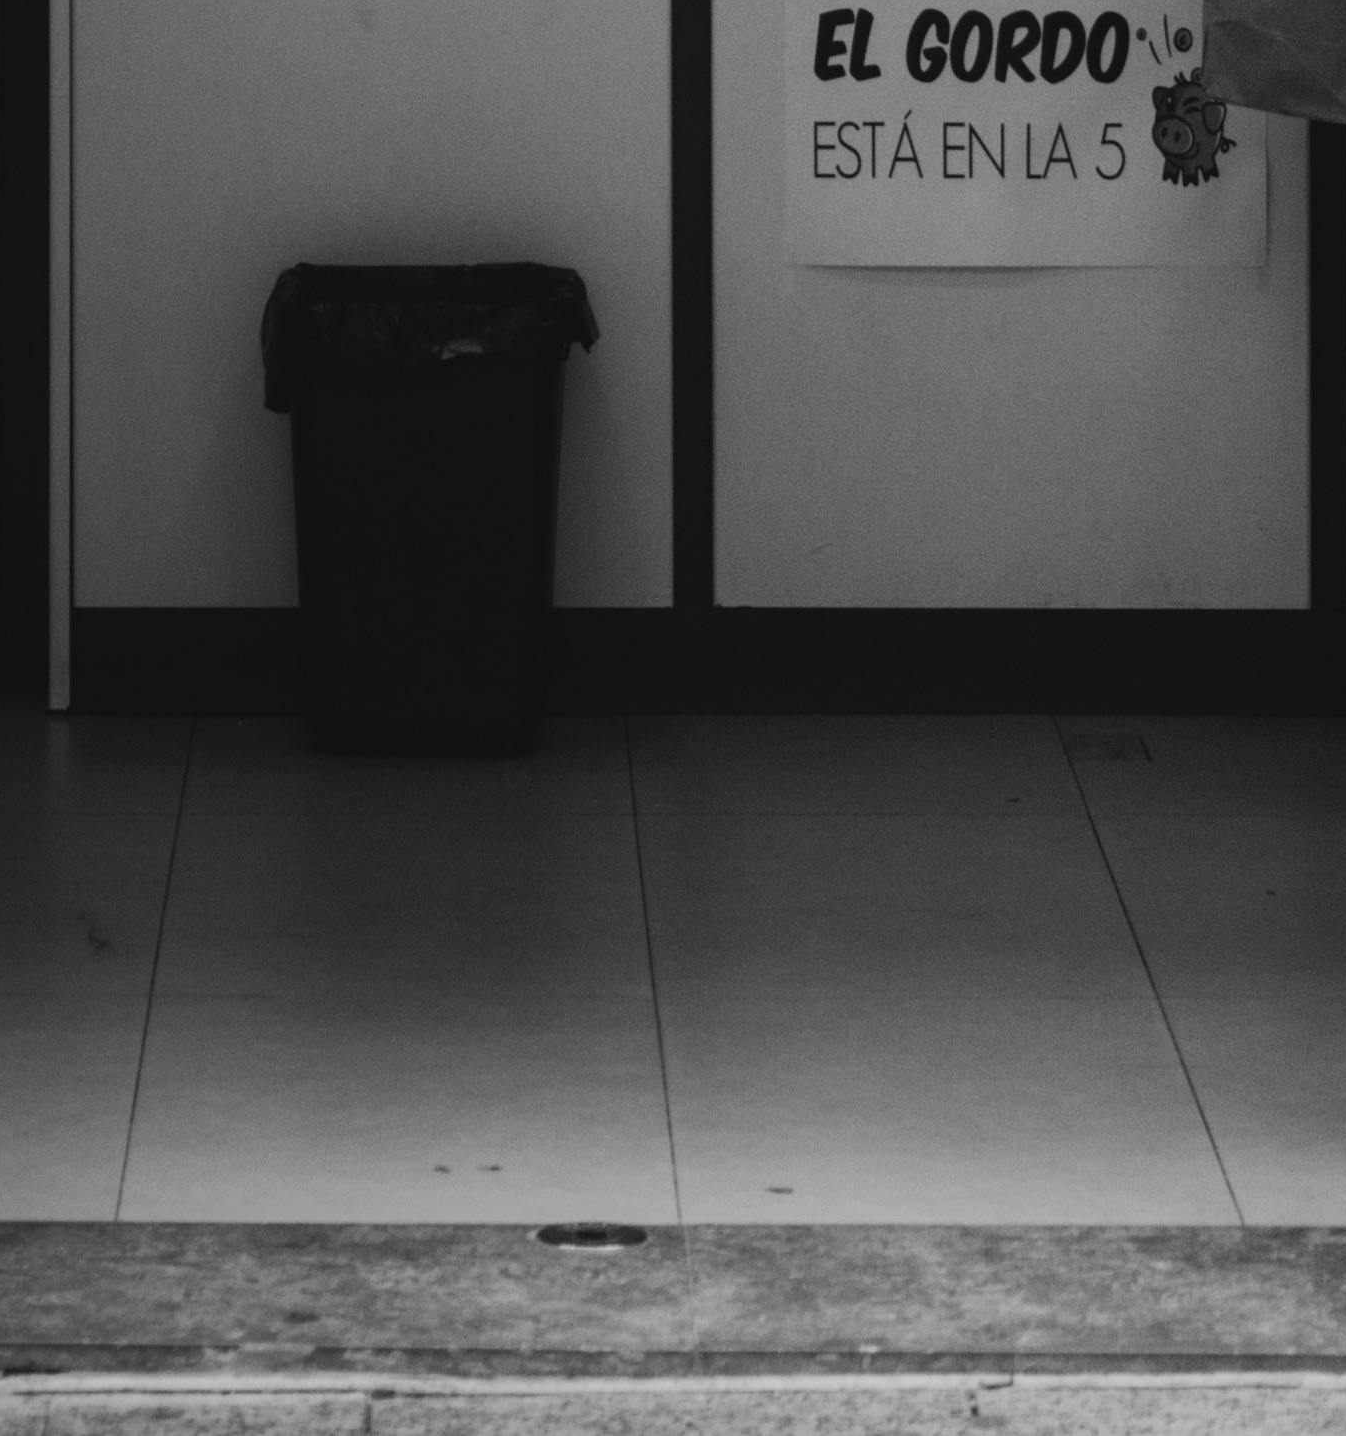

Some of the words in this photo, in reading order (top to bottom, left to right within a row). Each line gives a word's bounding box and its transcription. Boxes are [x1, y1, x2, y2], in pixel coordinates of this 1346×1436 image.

[813, 6, 882, 82] EL
[904, 8, 1131, 85] GORDO
[812, 107, 924, 180] ESTÁ
[942, 121, 1006, 180] EN
[1025, 122, 1079, 180] LA
[1095, 122, 1127, 181] 5
